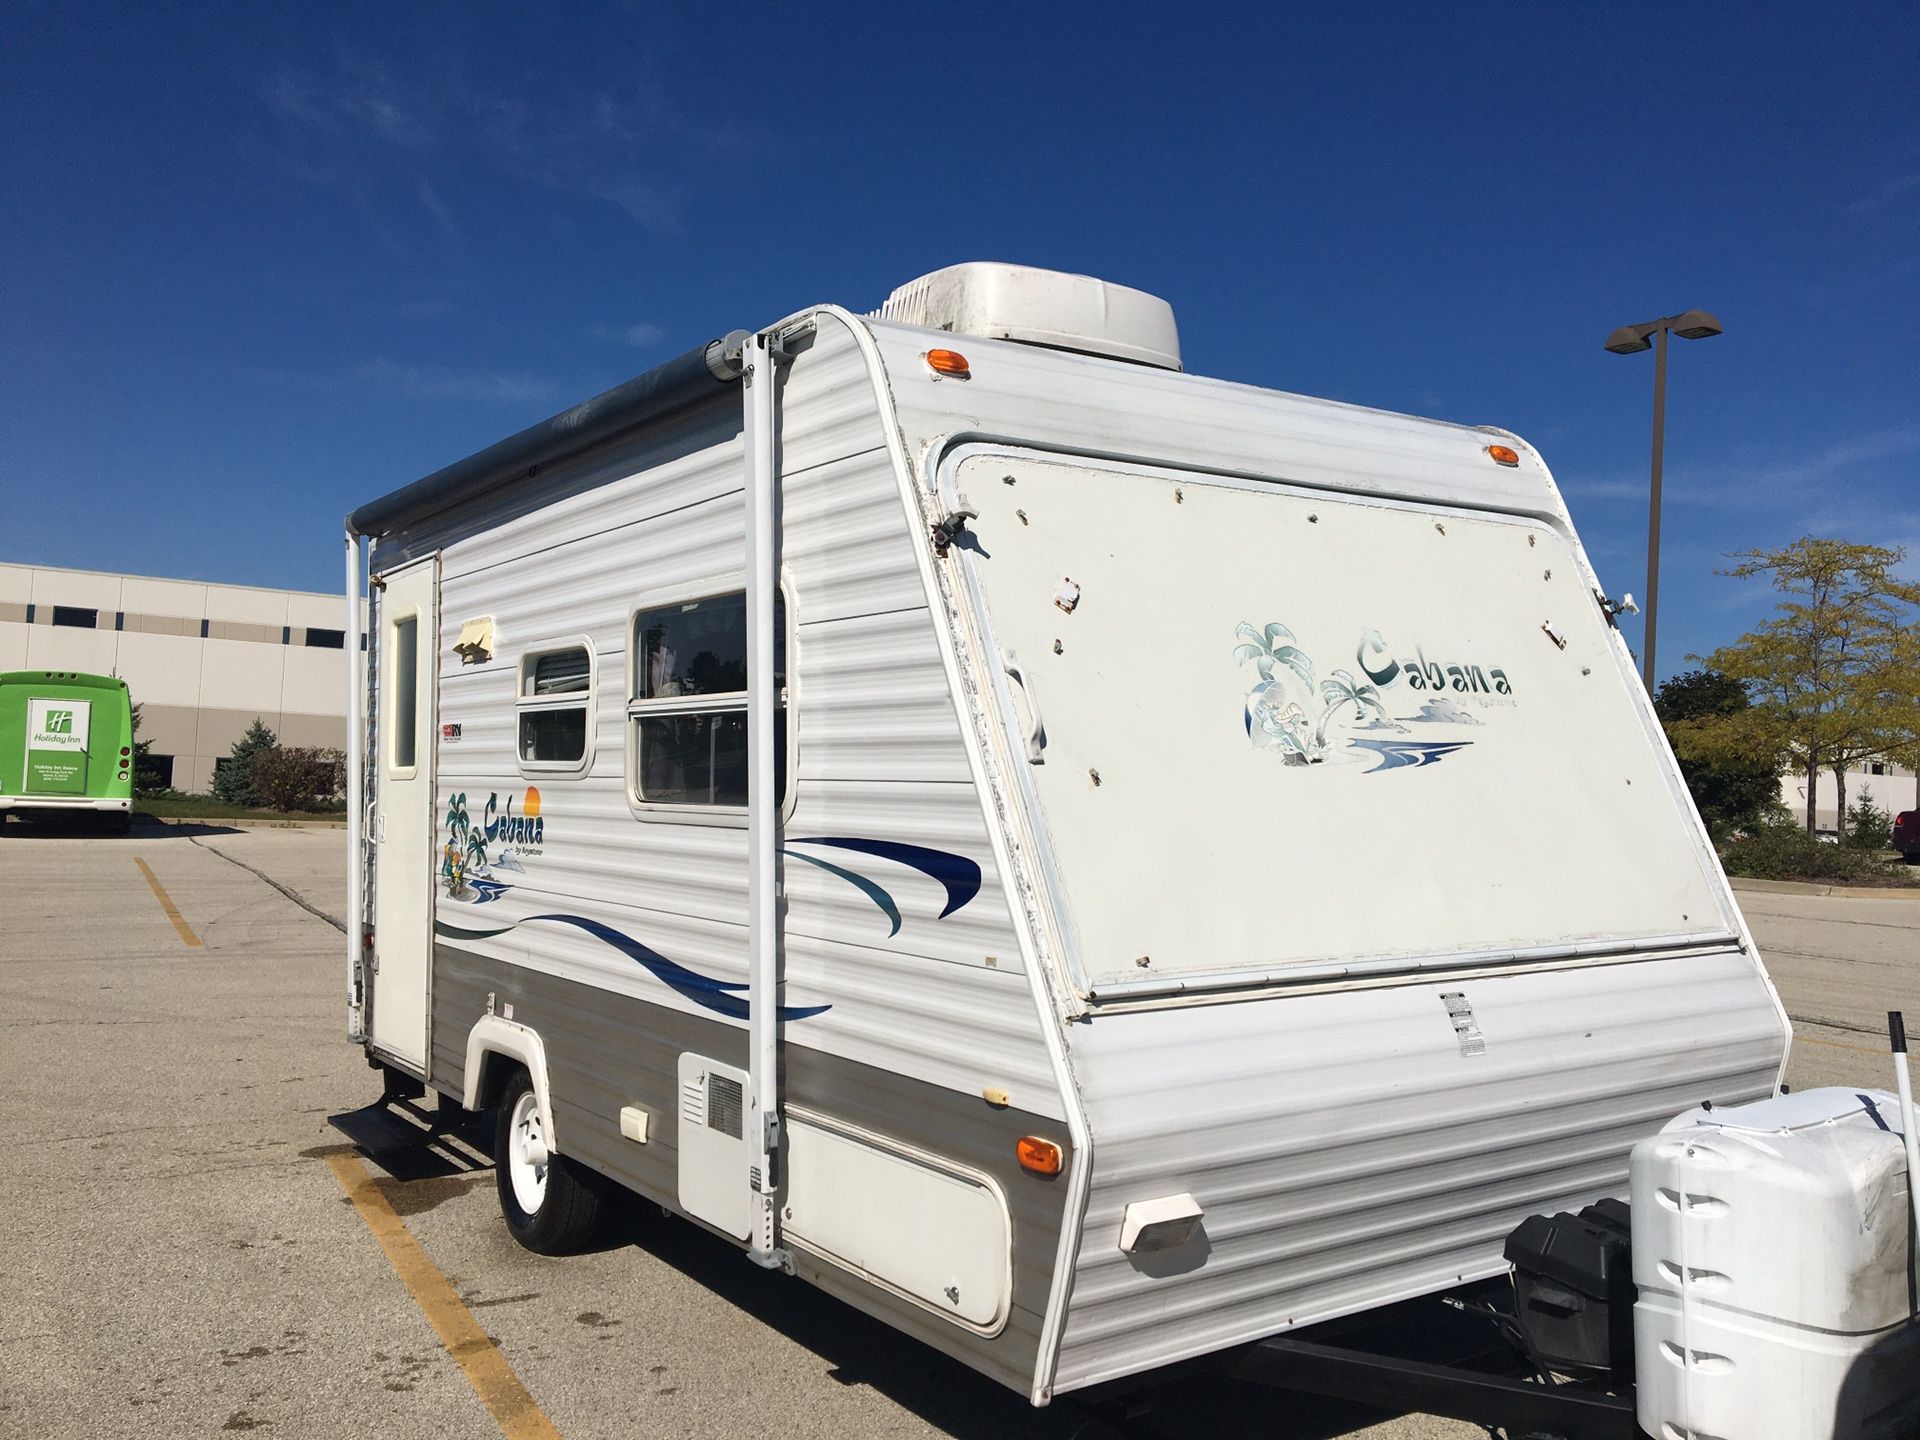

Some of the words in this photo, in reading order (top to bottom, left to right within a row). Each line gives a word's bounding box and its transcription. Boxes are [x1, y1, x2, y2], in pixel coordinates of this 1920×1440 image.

[1357, 628, 1512, 695] Cabana
[34, 733, 66, 744] Holiday
[484, 791, 544, 845] Cabana
